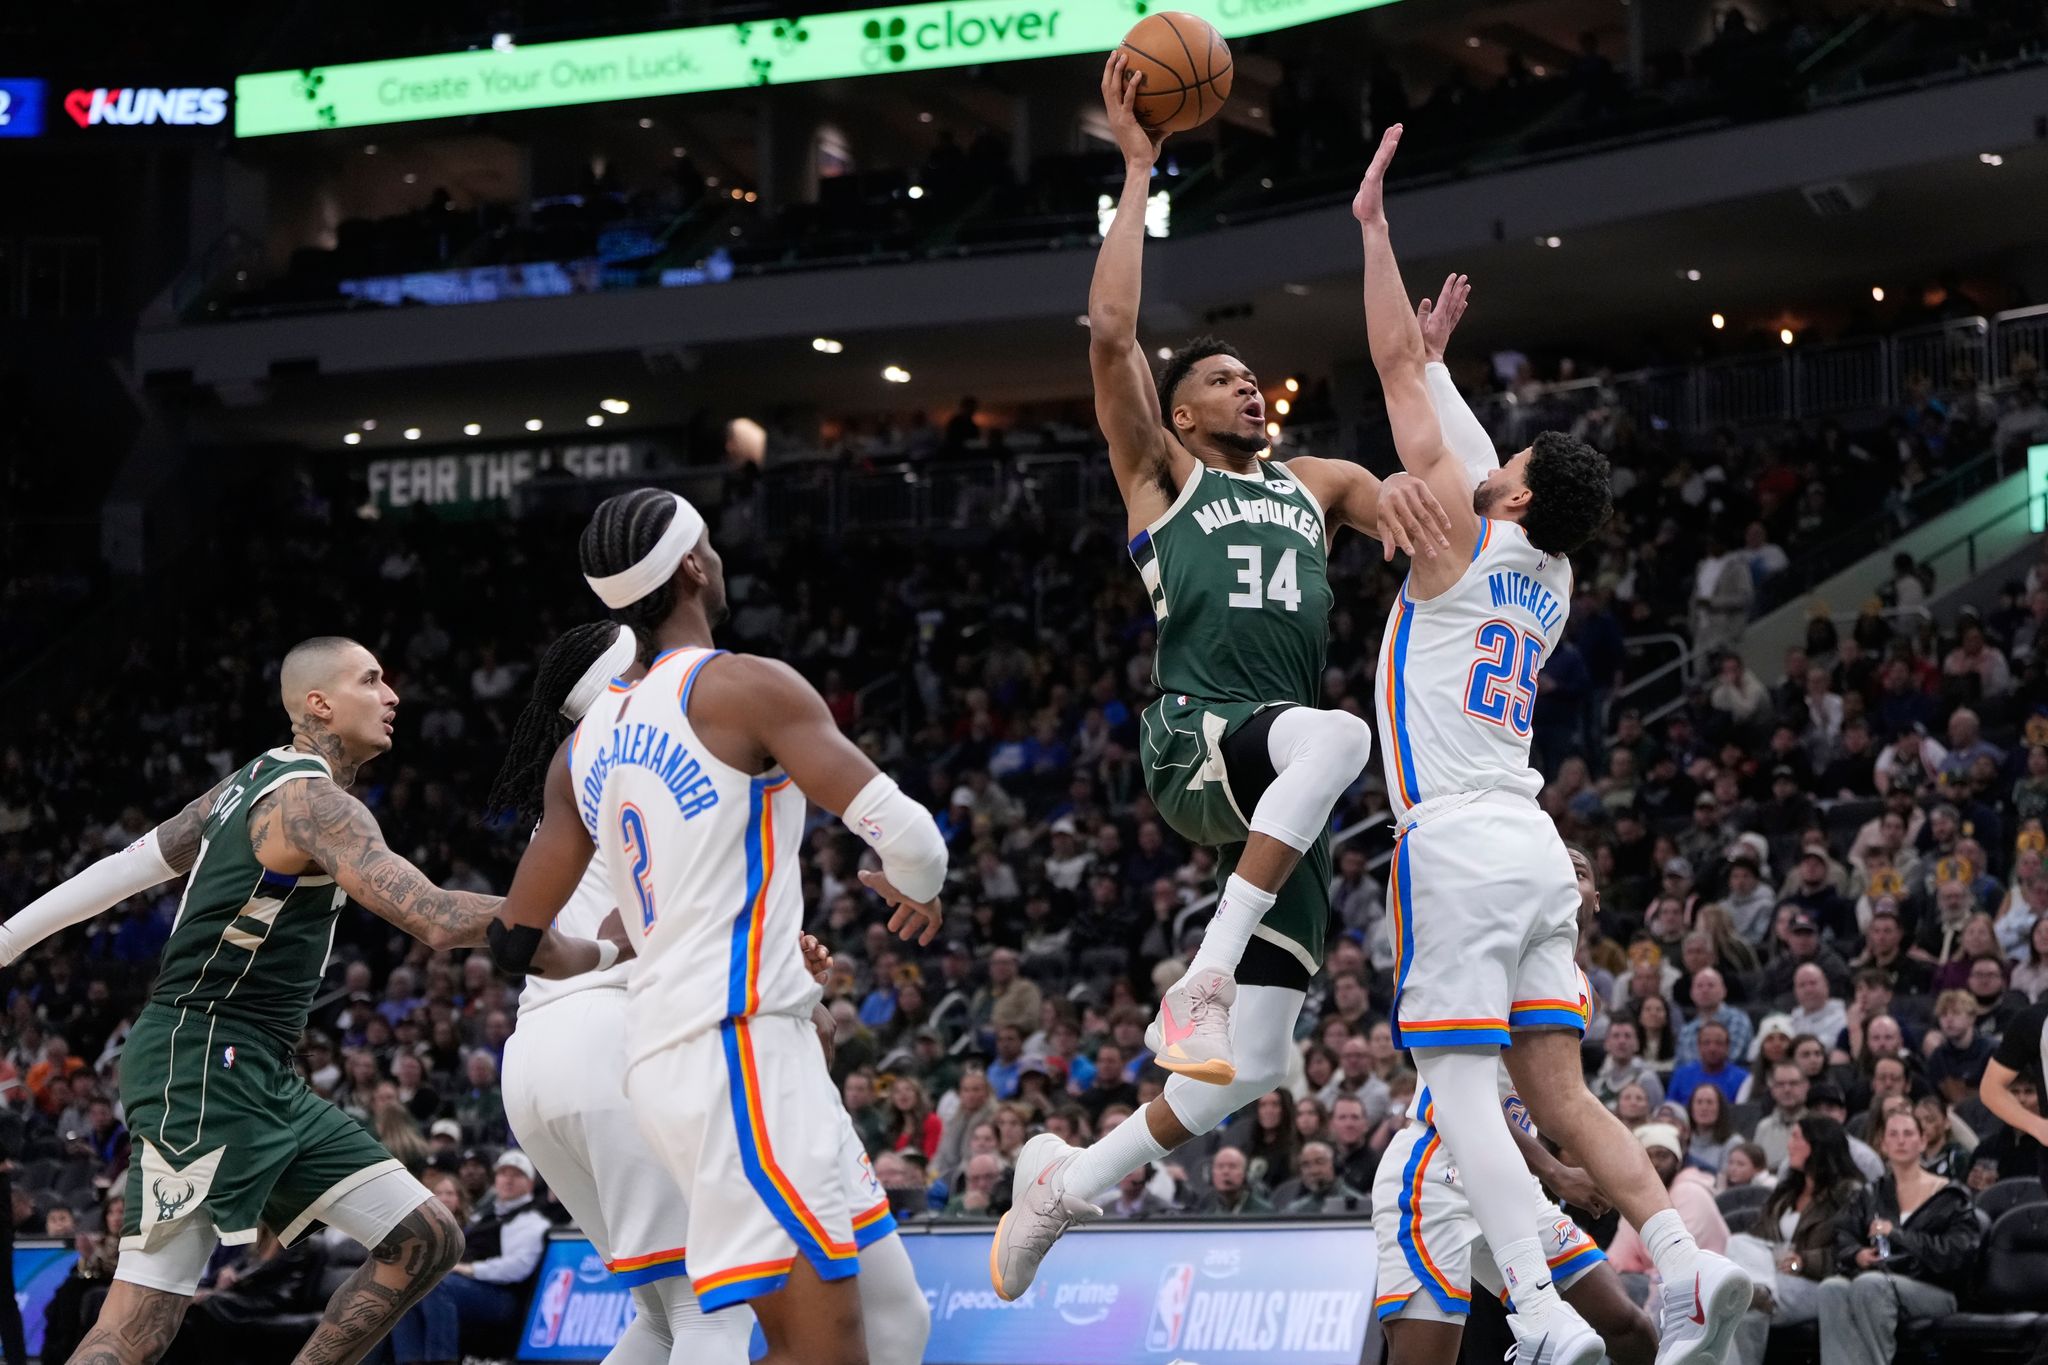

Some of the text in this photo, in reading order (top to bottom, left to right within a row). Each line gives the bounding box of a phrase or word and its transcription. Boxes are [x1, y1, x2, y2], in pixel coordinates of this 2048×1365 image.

[916, 10, 1059, 50] clover
[88, 87, 228, 125] KUNES
[378, 76, 469, 106] Create
[478, 67, 541, 94] Your
[550, 58, 618, 89] Own
[368, 456, 459, 507] FEAR
[1192, 497, 1322, 548] MILWAUKEE
[1227, 545, 1302, 611] 34
[1488, 571, 1562, 637] MITCHELL
[1463, 619, 1546, 738] 25
[617, 801, 658, 937] 2
[1053, 1277, 1119, 1309] prime
[1182, 1290, 1363, 1350] RIVALS WEEK
